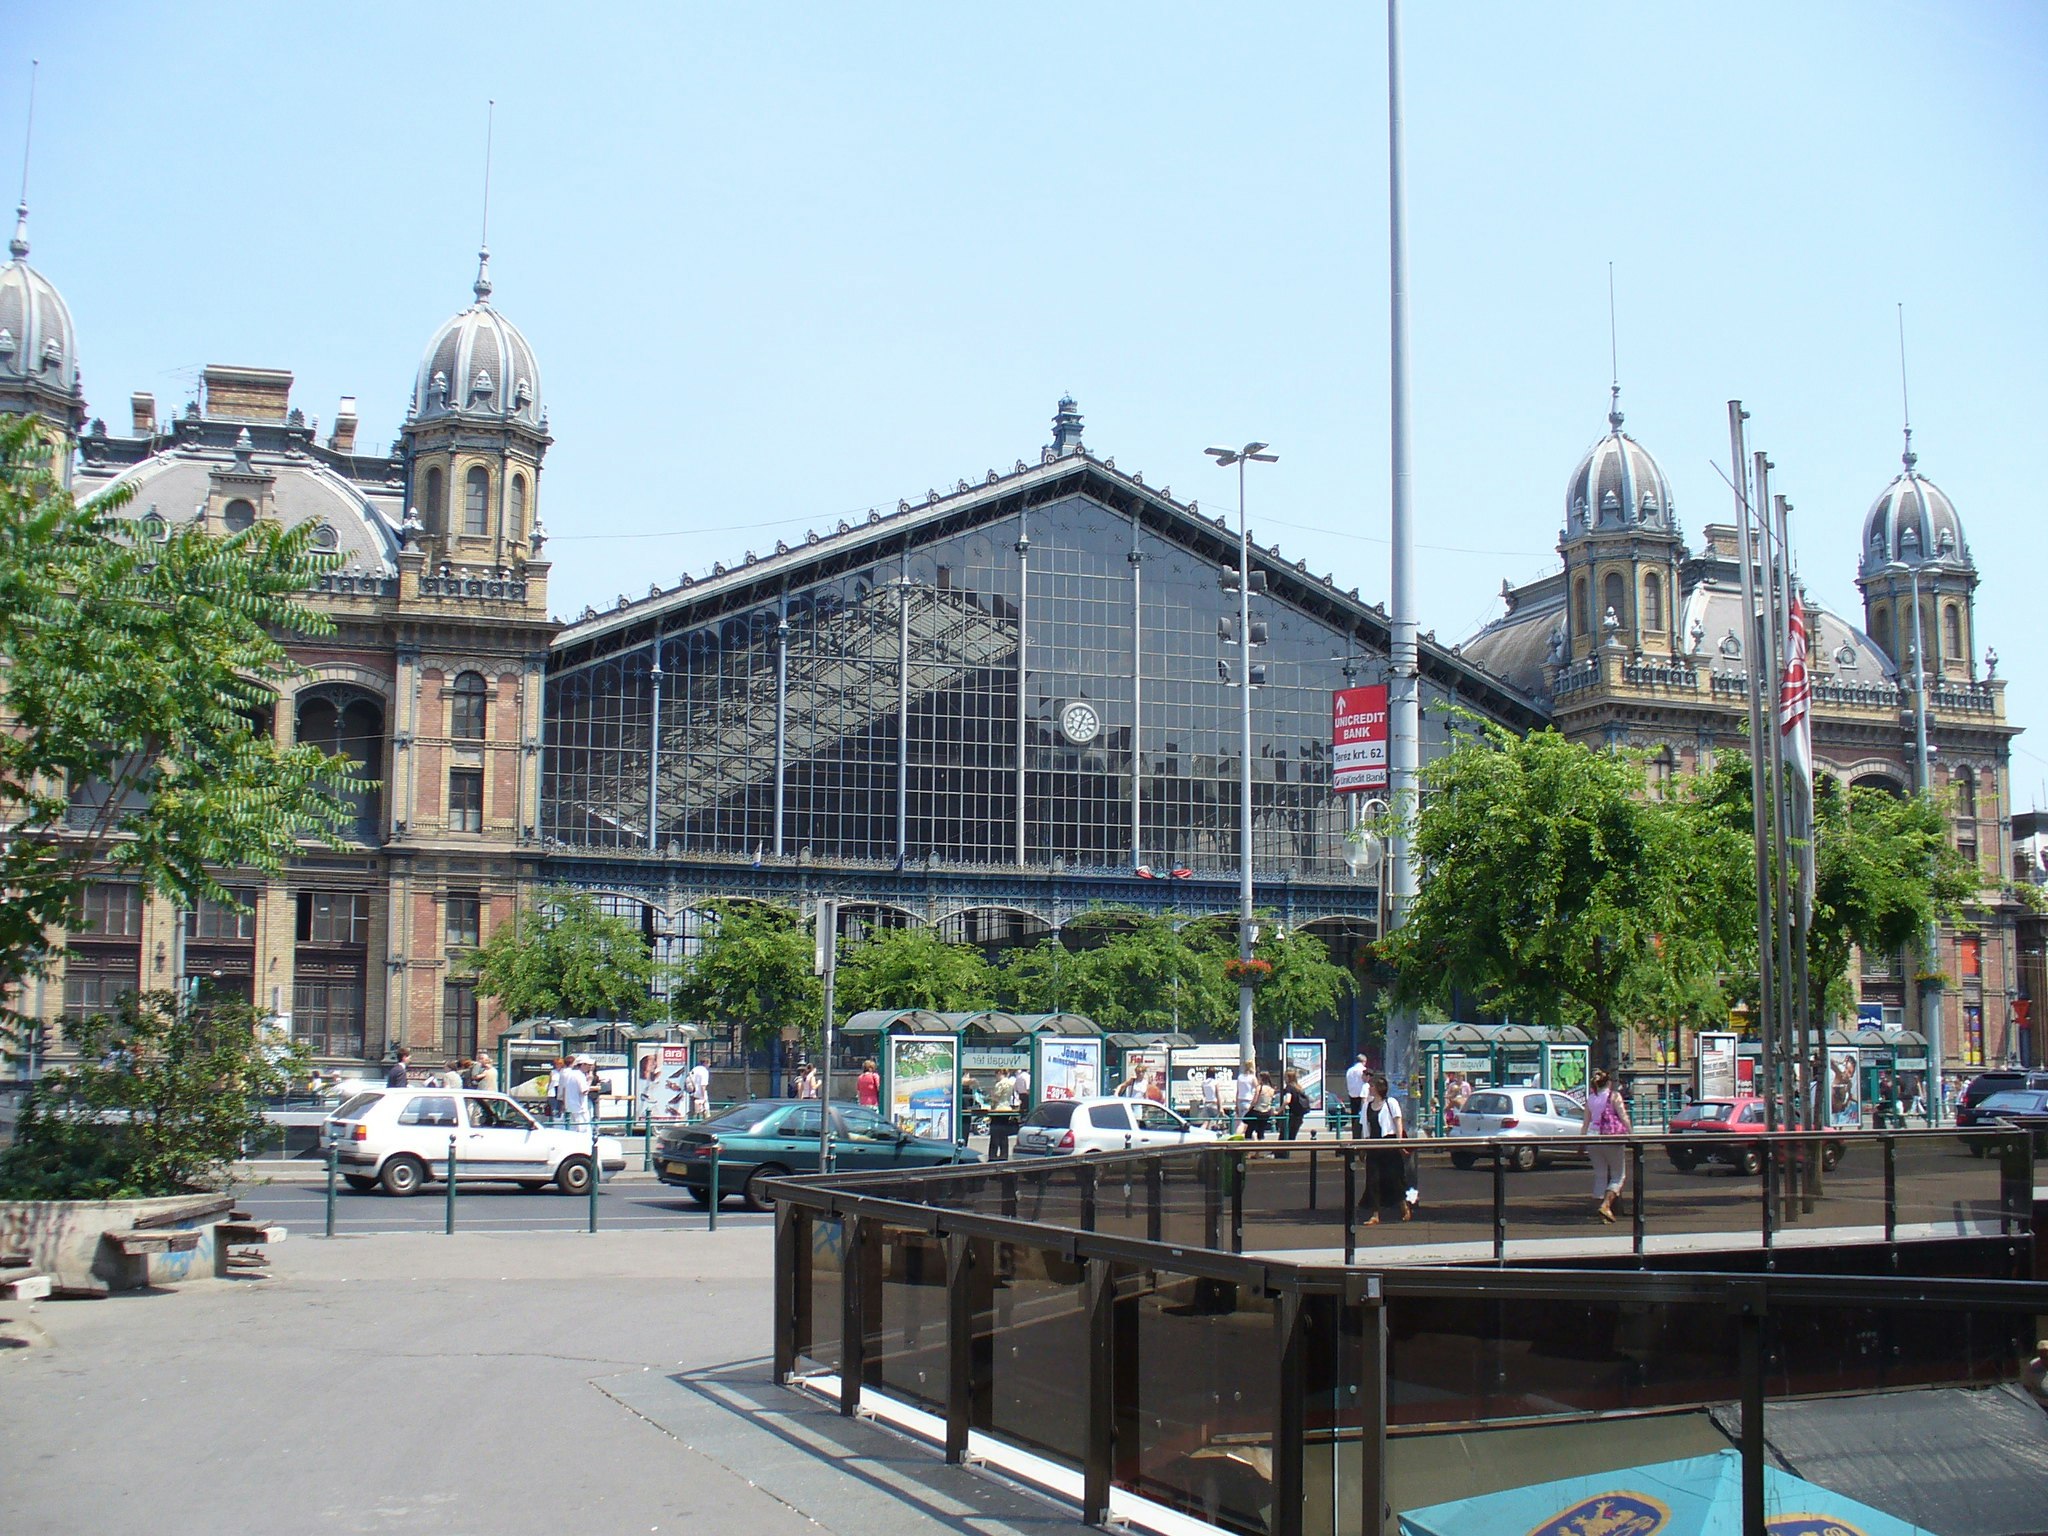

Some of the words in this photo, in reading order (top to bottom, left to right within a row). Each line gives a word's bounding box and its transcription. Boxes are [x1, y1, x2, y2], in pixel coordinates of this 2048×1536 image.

[1335, 712, 1385, 728] UNICREDIT
[1344, 727, 1371, 740] BANK
[1335, 750, 1351, 762] Teréz
[1353, 749, 1368, 760] krt.
[1370, 748, 1384, 759] 62.
[1340, 773, 1365, 785] UniCredit
[1366, 772, 1385, 783] Bank
[665, 1049, 682, 1058] ara
